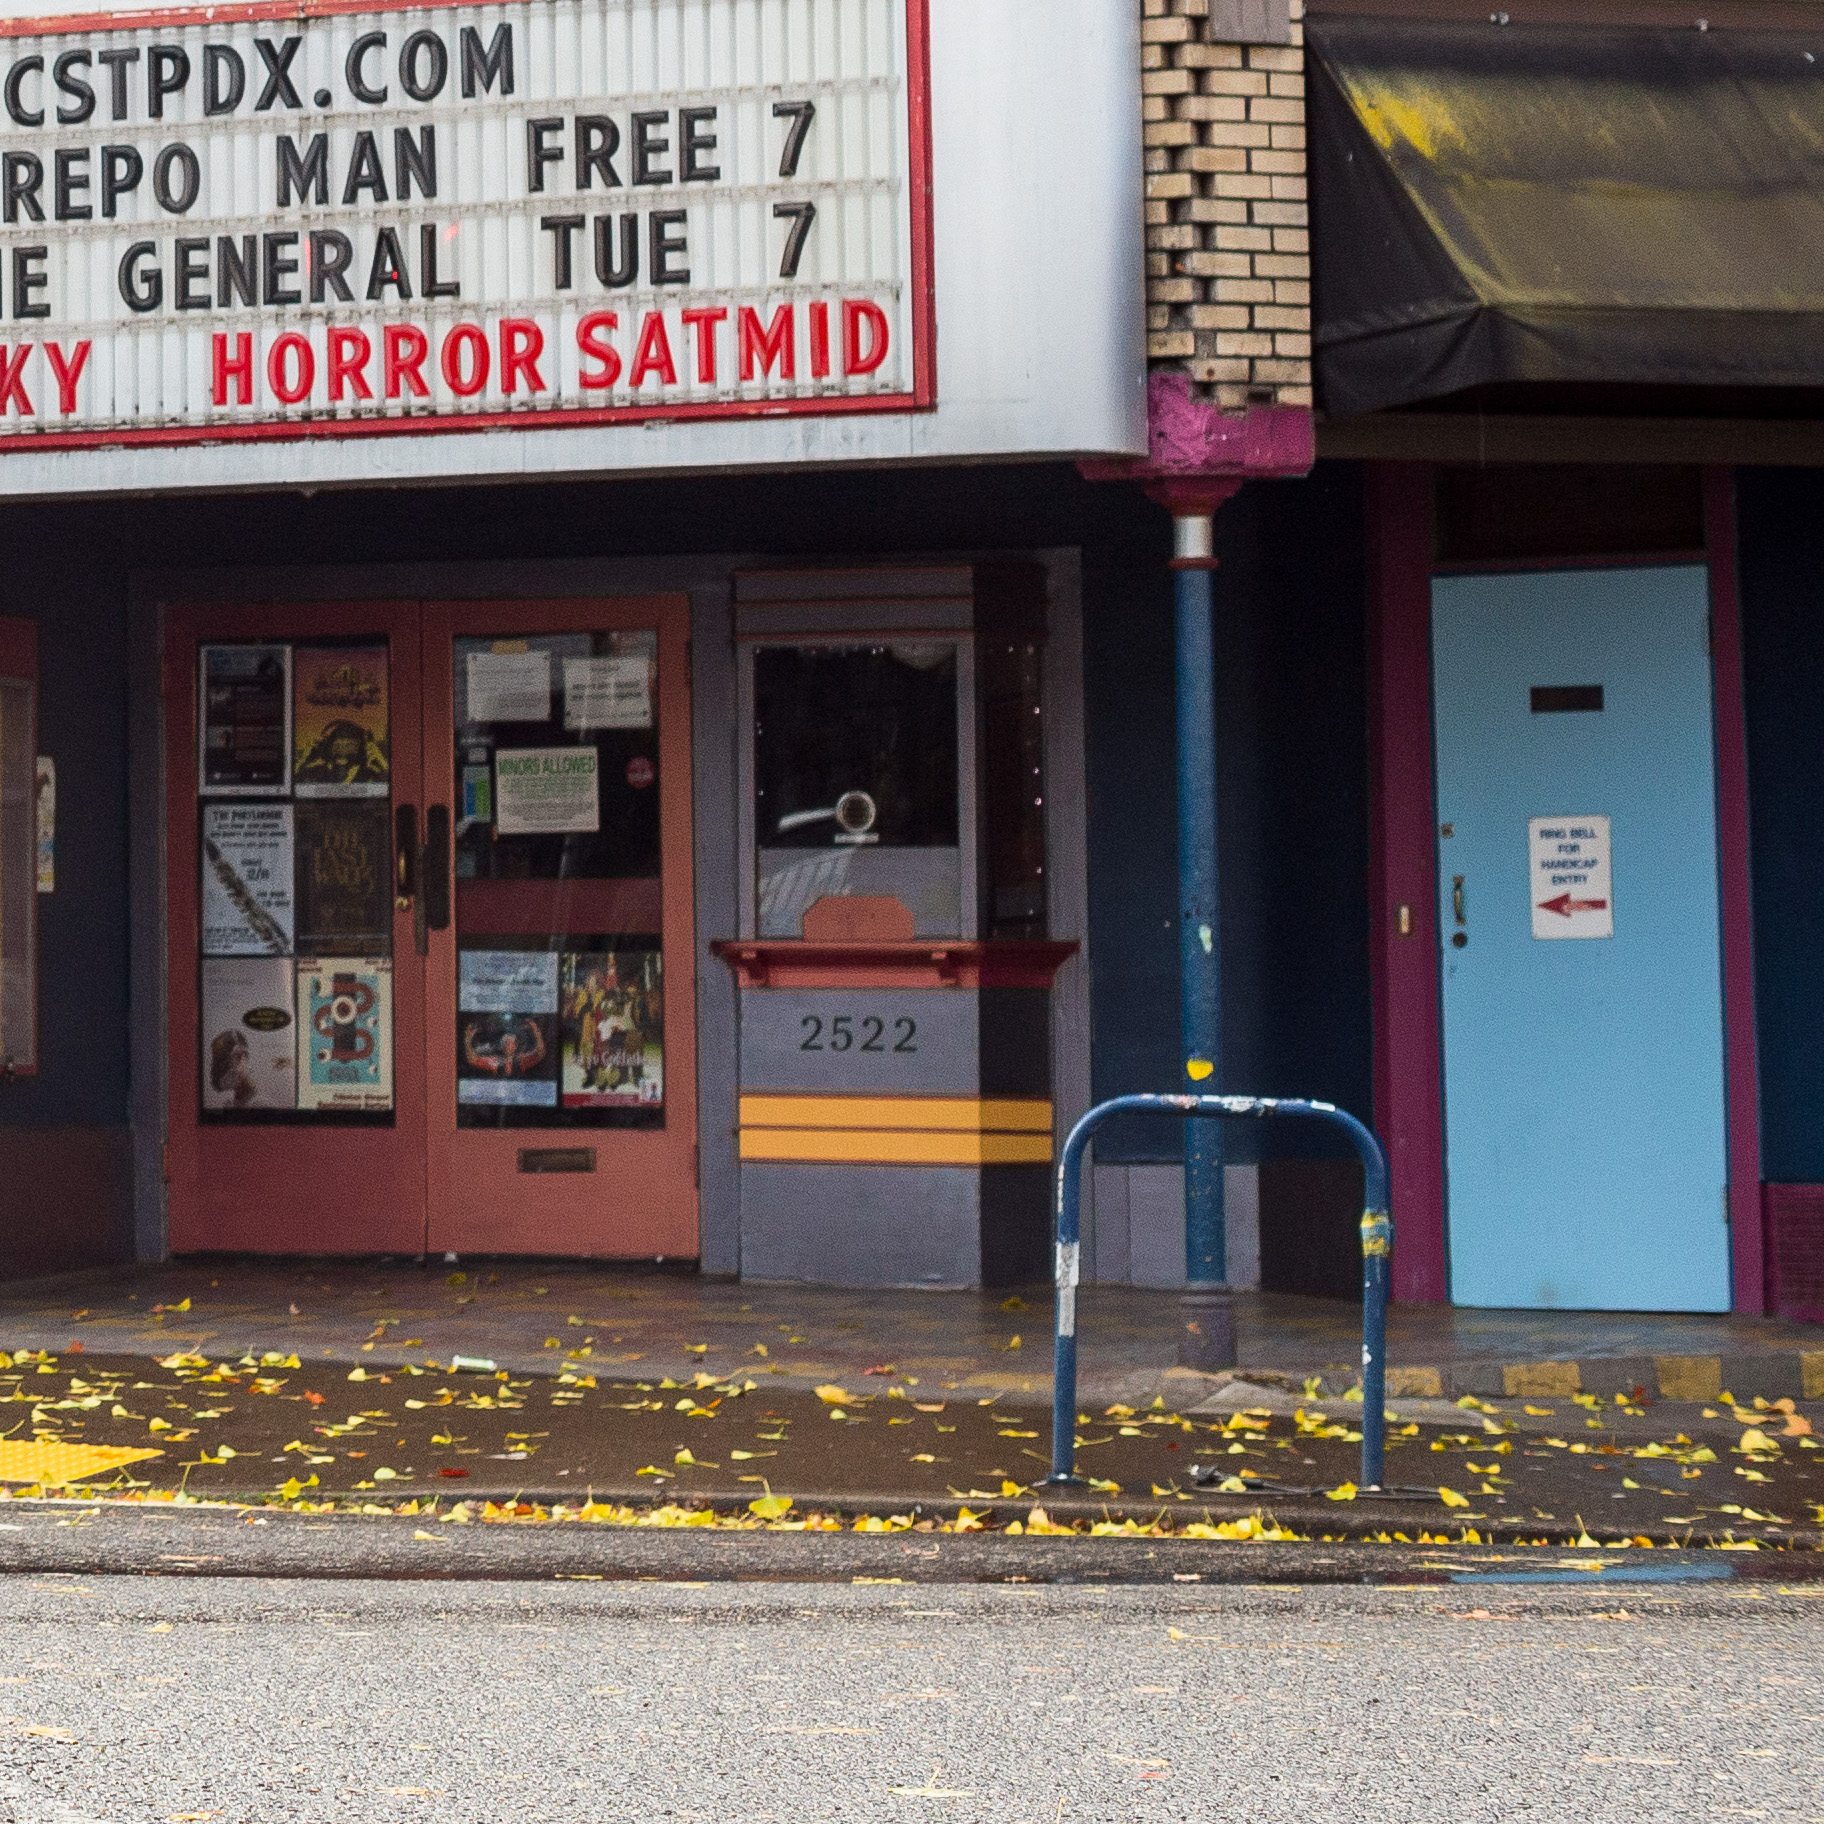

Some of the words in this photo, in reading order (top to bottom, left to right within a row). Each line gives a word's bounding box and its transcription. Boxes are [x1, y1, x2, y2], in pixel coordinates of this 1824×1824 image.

[3, 21, 517, 128] CSTPDX.COM
[1, 140, 204, 225] REPO
[276, 124, 439, 207] MAN
[525, 108, 722, 193] FREE
[772, 98, 819, 178] 7
[118, 223, 462, 312] GENERAL
[540, 208, 693, 292] TUE
[772, 199, 819, 278] 7
[542, 755, 596, 774] ALLOWED
[1570, 827, 1597, 839] BELL
[1558, 843, 1580, 853] FOR
[1540, 858, 1599, 870] HANDICAP
[1552, 874, 1588, 886] ENTRY
[799, 1014, 919, 1054] 2522
